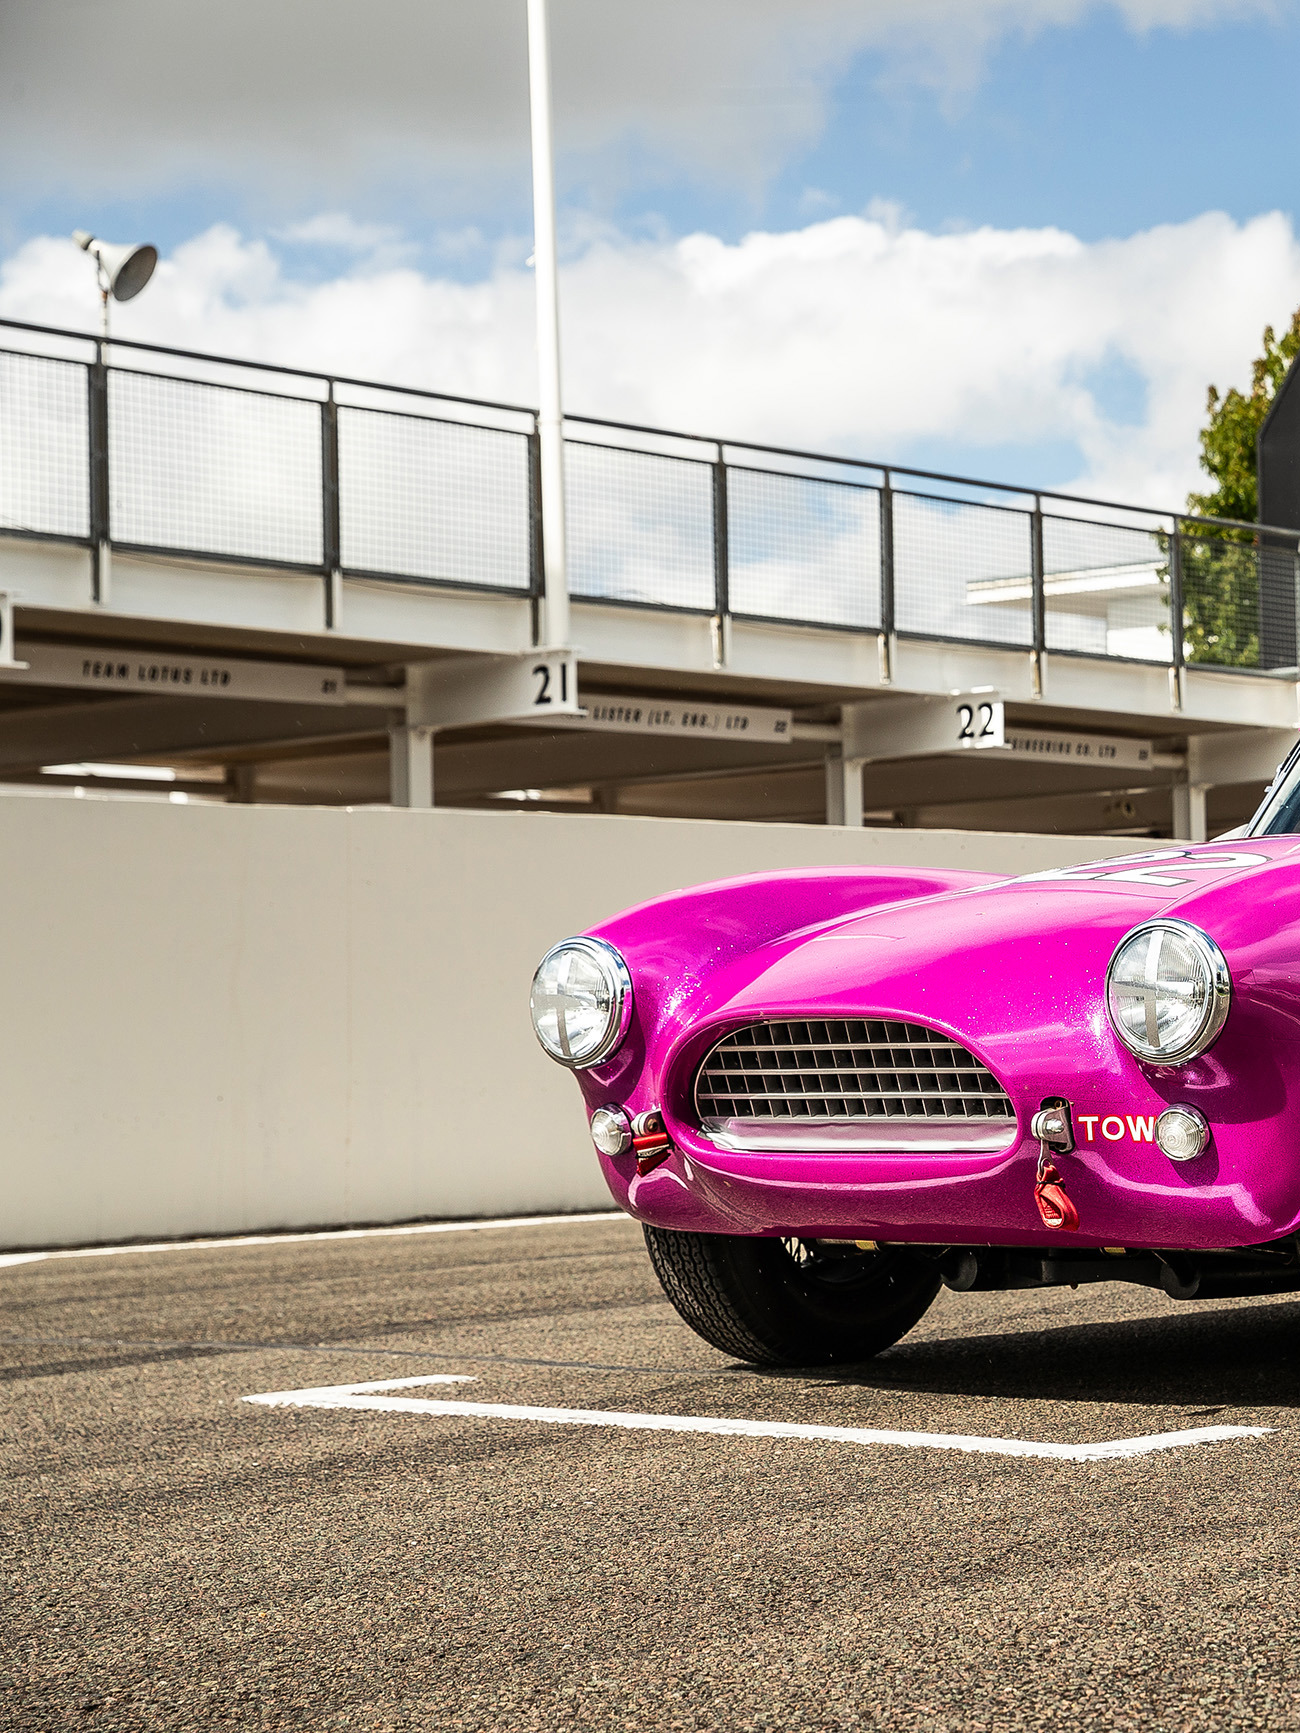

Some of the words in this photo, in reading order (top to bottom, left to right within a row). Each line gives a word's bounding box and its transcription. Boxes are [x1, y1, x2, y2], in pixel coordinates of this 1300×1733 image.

[82, 660, 130, 680] TEAM
[137, 663, 193, 685] LOTUS
[532, 663, 567, 705] 21
[957, 702, 995, 740] 22
[1078, 1114, 1156, 1144] TOW
